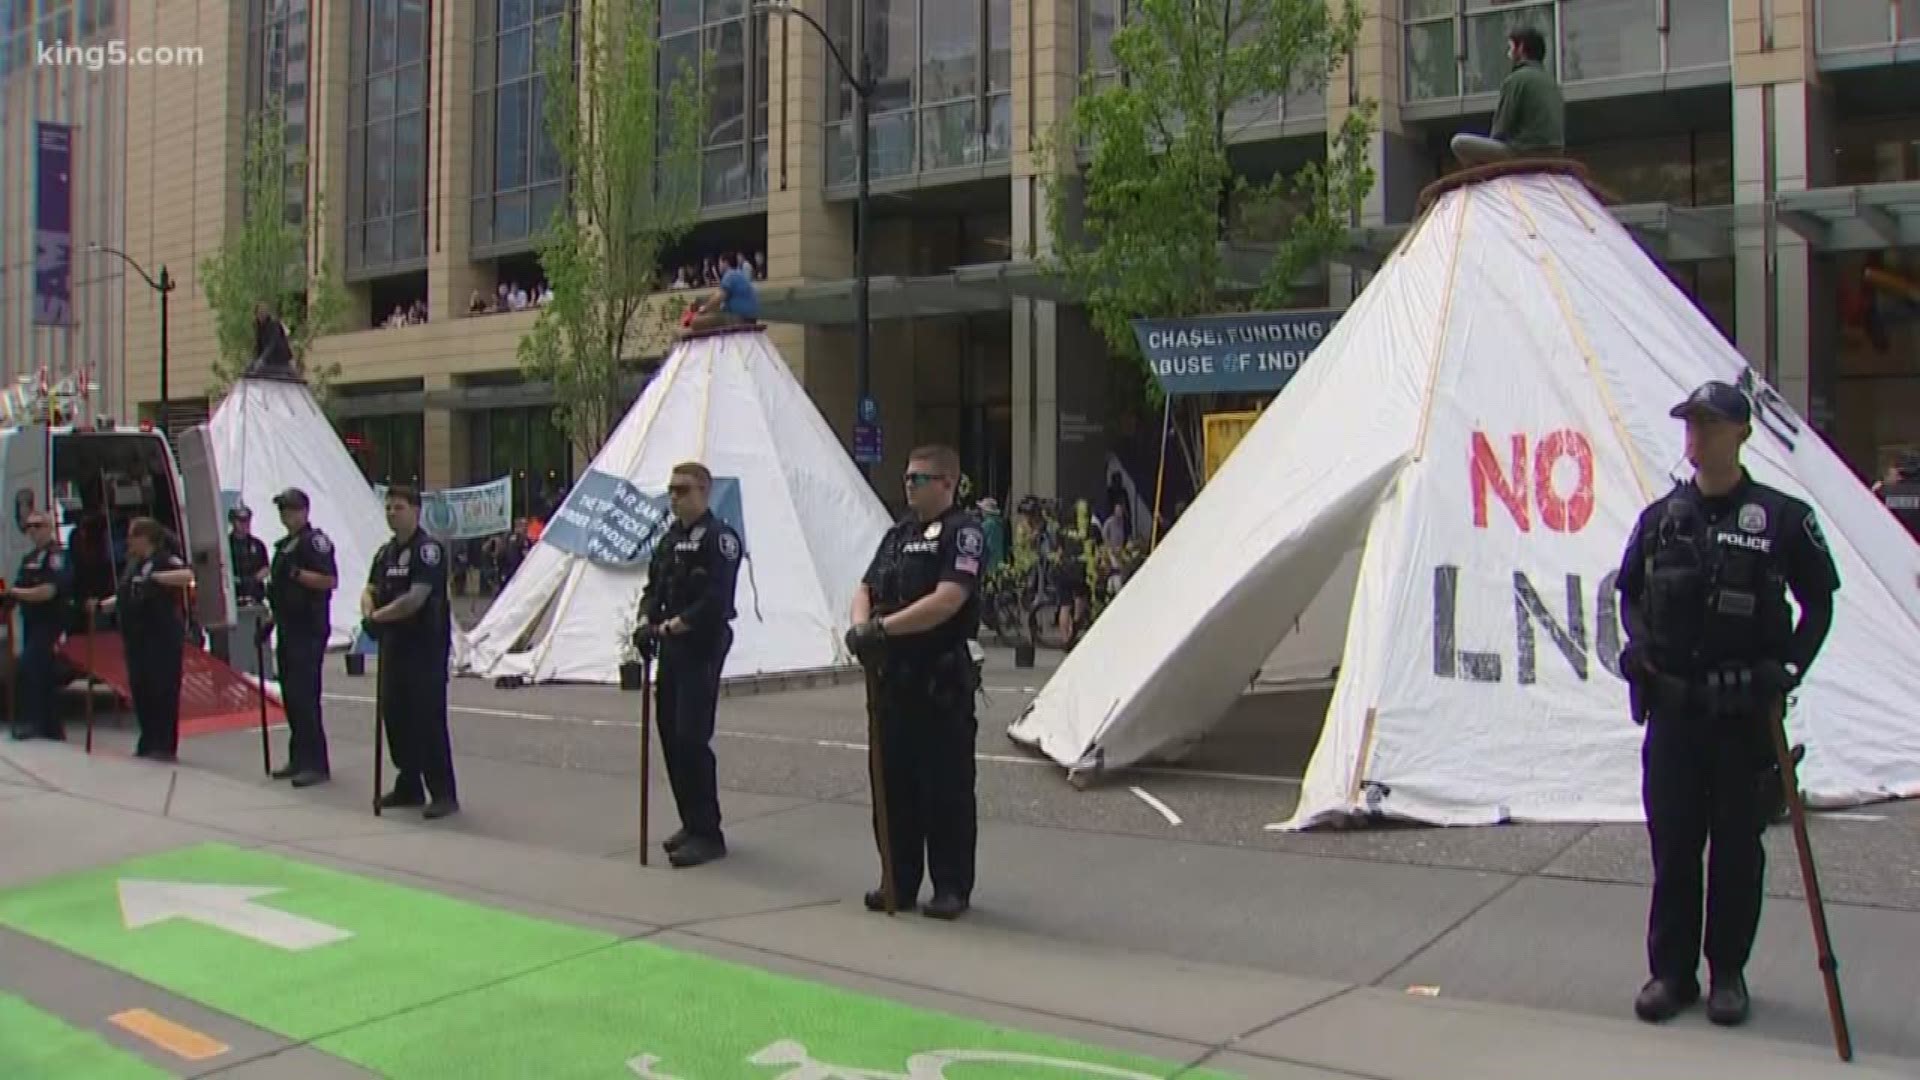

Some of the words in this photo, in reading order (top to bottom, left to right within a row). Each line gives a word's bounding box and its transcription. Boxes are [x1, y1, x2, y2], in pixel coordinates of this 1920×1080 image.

[1226, 322, 1322, 344] FUNDING
[1257, 350, 1310, 372] INDI
[1470, 430, 1595, 533] NO
[1717, 531, 1771, 553] POLICE
